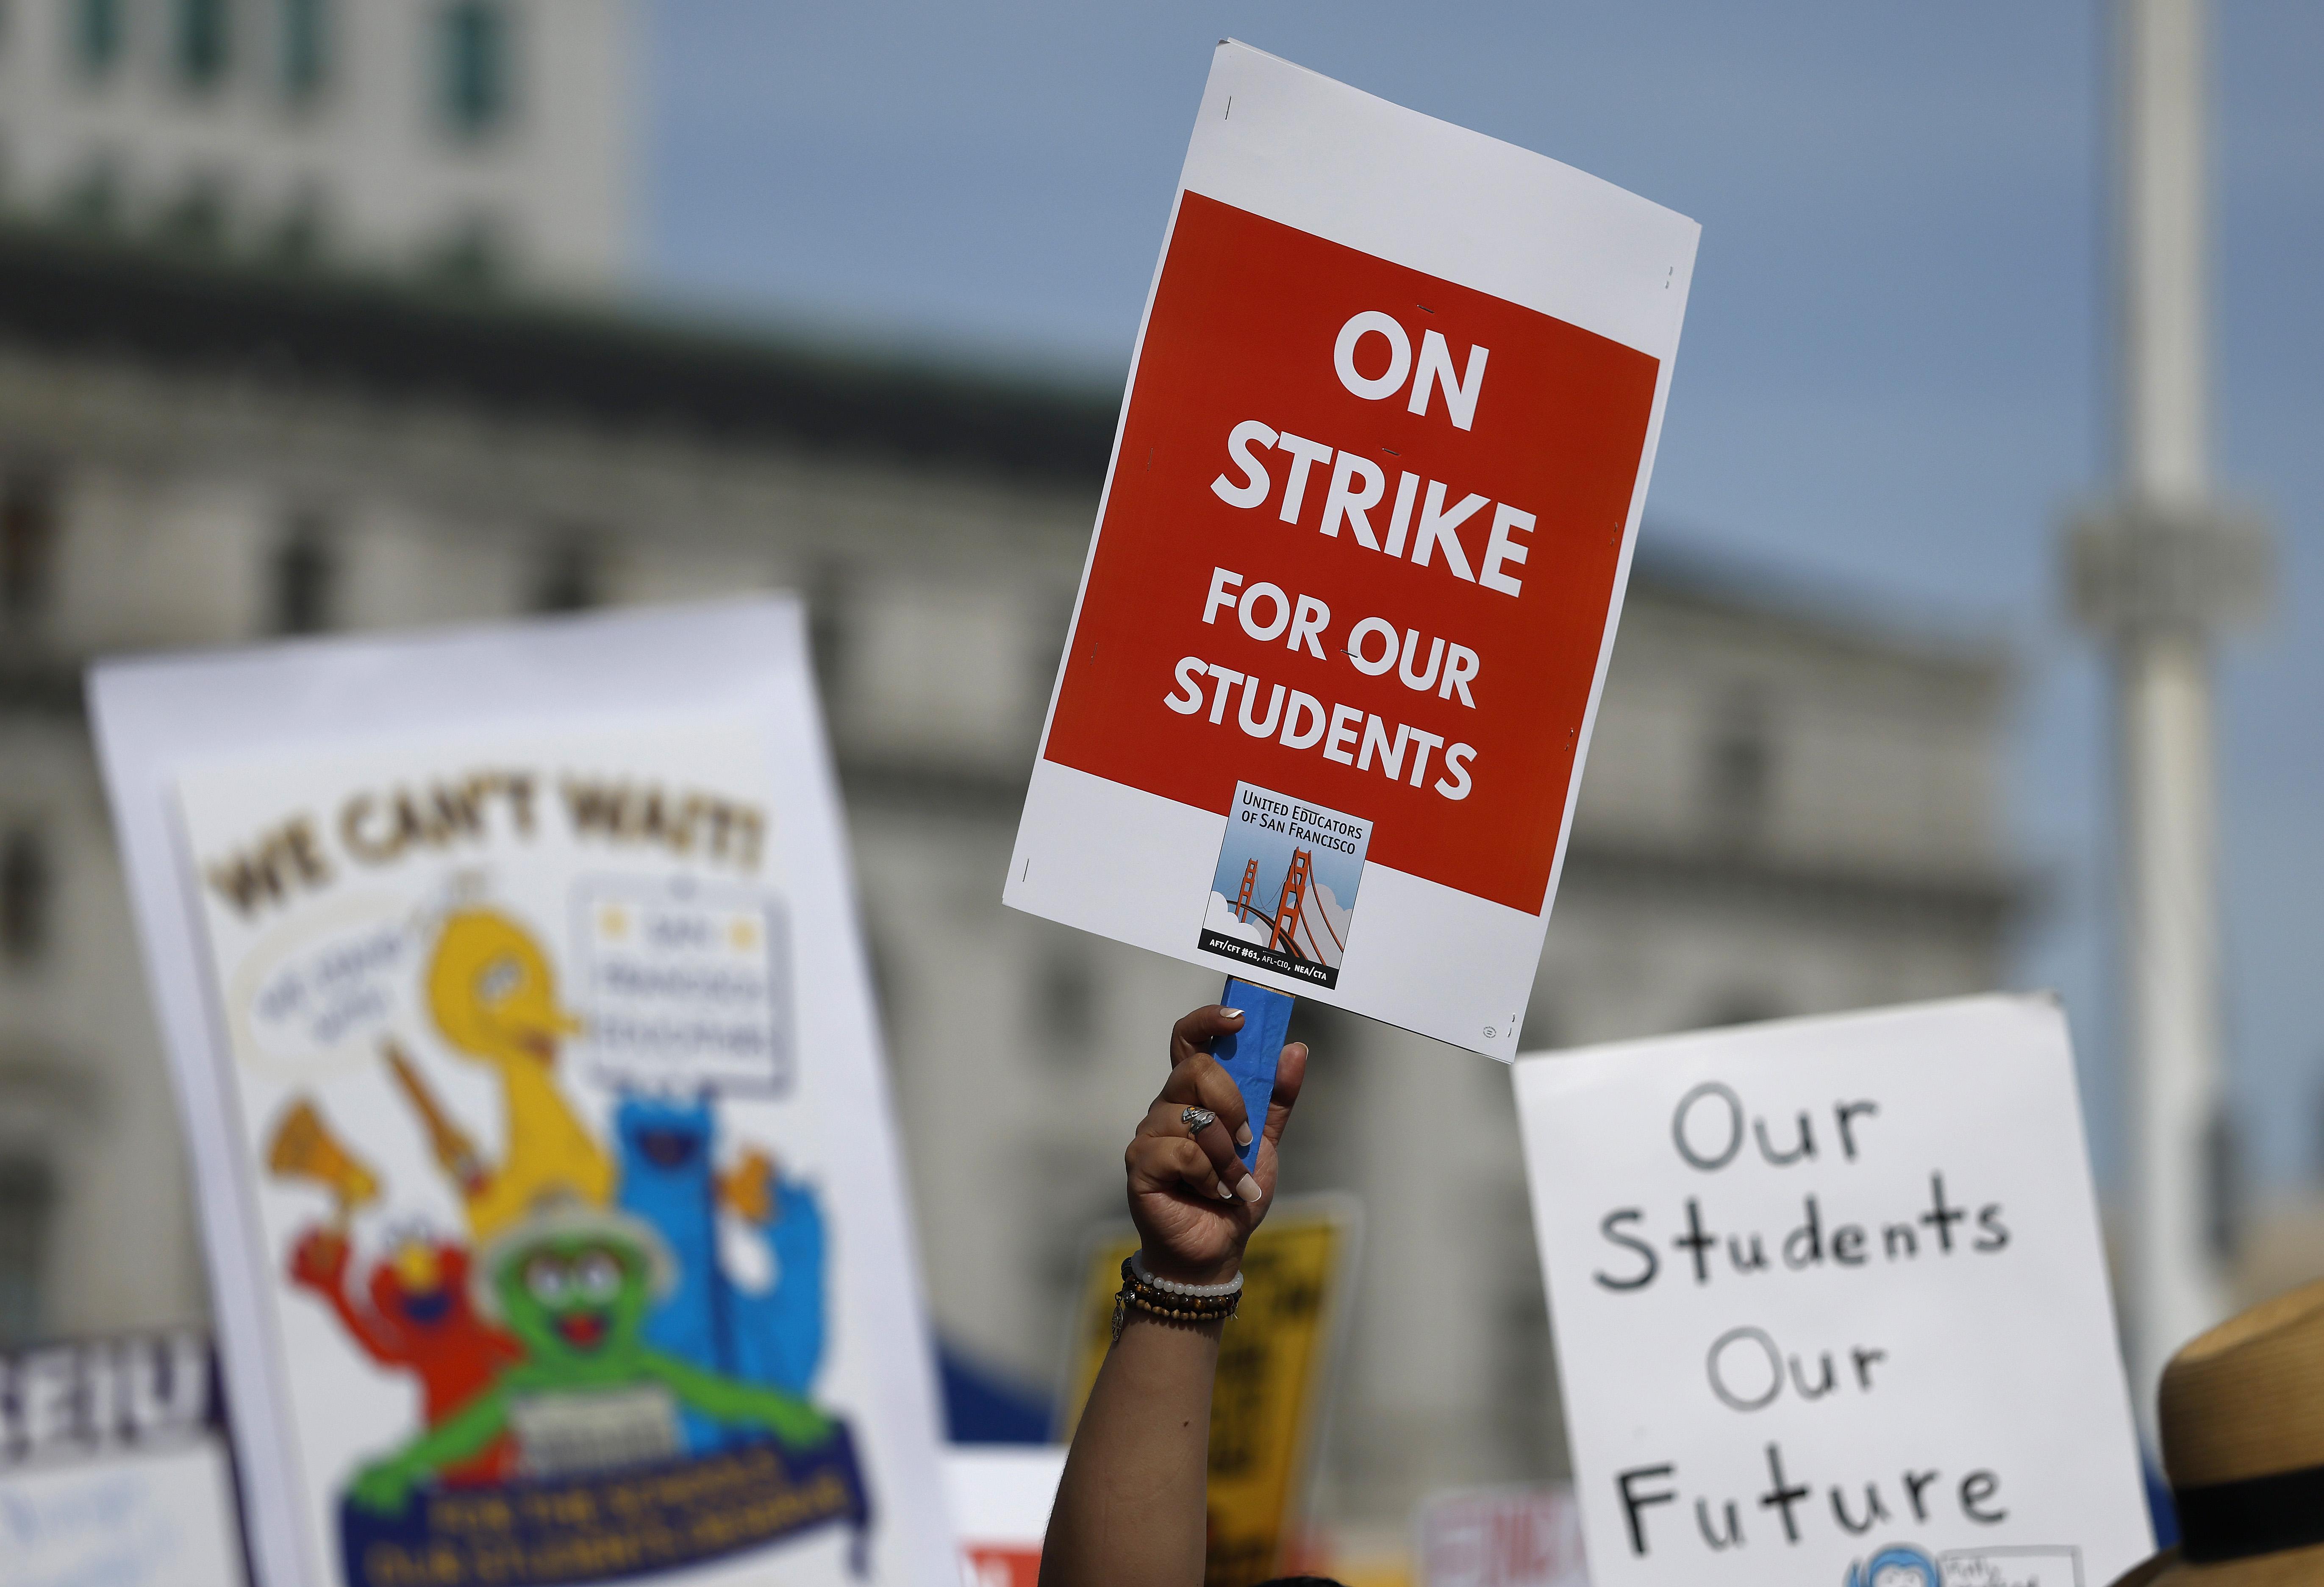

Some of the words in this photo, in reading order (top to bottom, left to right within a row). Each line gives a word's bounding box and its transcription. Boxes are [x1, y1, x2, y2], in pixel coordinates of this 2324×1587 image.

[1333, 310, 1490, 432] ON
[1210, 420, 1537, 598] STRIKE
[1202, 566, 1331, 661] FOR
[1347, 617, 1480, 709] OUR
[1163, 656, 1478, 801] STUDENTS
[209, 817, 330, 919] WE
[339, 773, 536, 864] CAN'T
[561, 781, 767, 874] WAIT!
[1242, 789, 1288, 816] UNITED
[1291, 805, 1363, 839] EDUCATORS
[1259, 813, 1286, 834] SAN
[1288, 821, 1355, 855] FRANCISCO
[1209, 939, 1241, 954] AFT/CFT
[1241, 947, 1261, 962] #61,
[1261, 955, 1291, 971] AFL-CIO,
[1294, 964, 1327, 981] NEA/CTA
[1672, 1081, 1880, 1172] Our
[1593, 1168, 2010, 1294] Students
[1706, 1326, 1888, 1412] Our
[1614, 1441, 2010, 1557] Future
